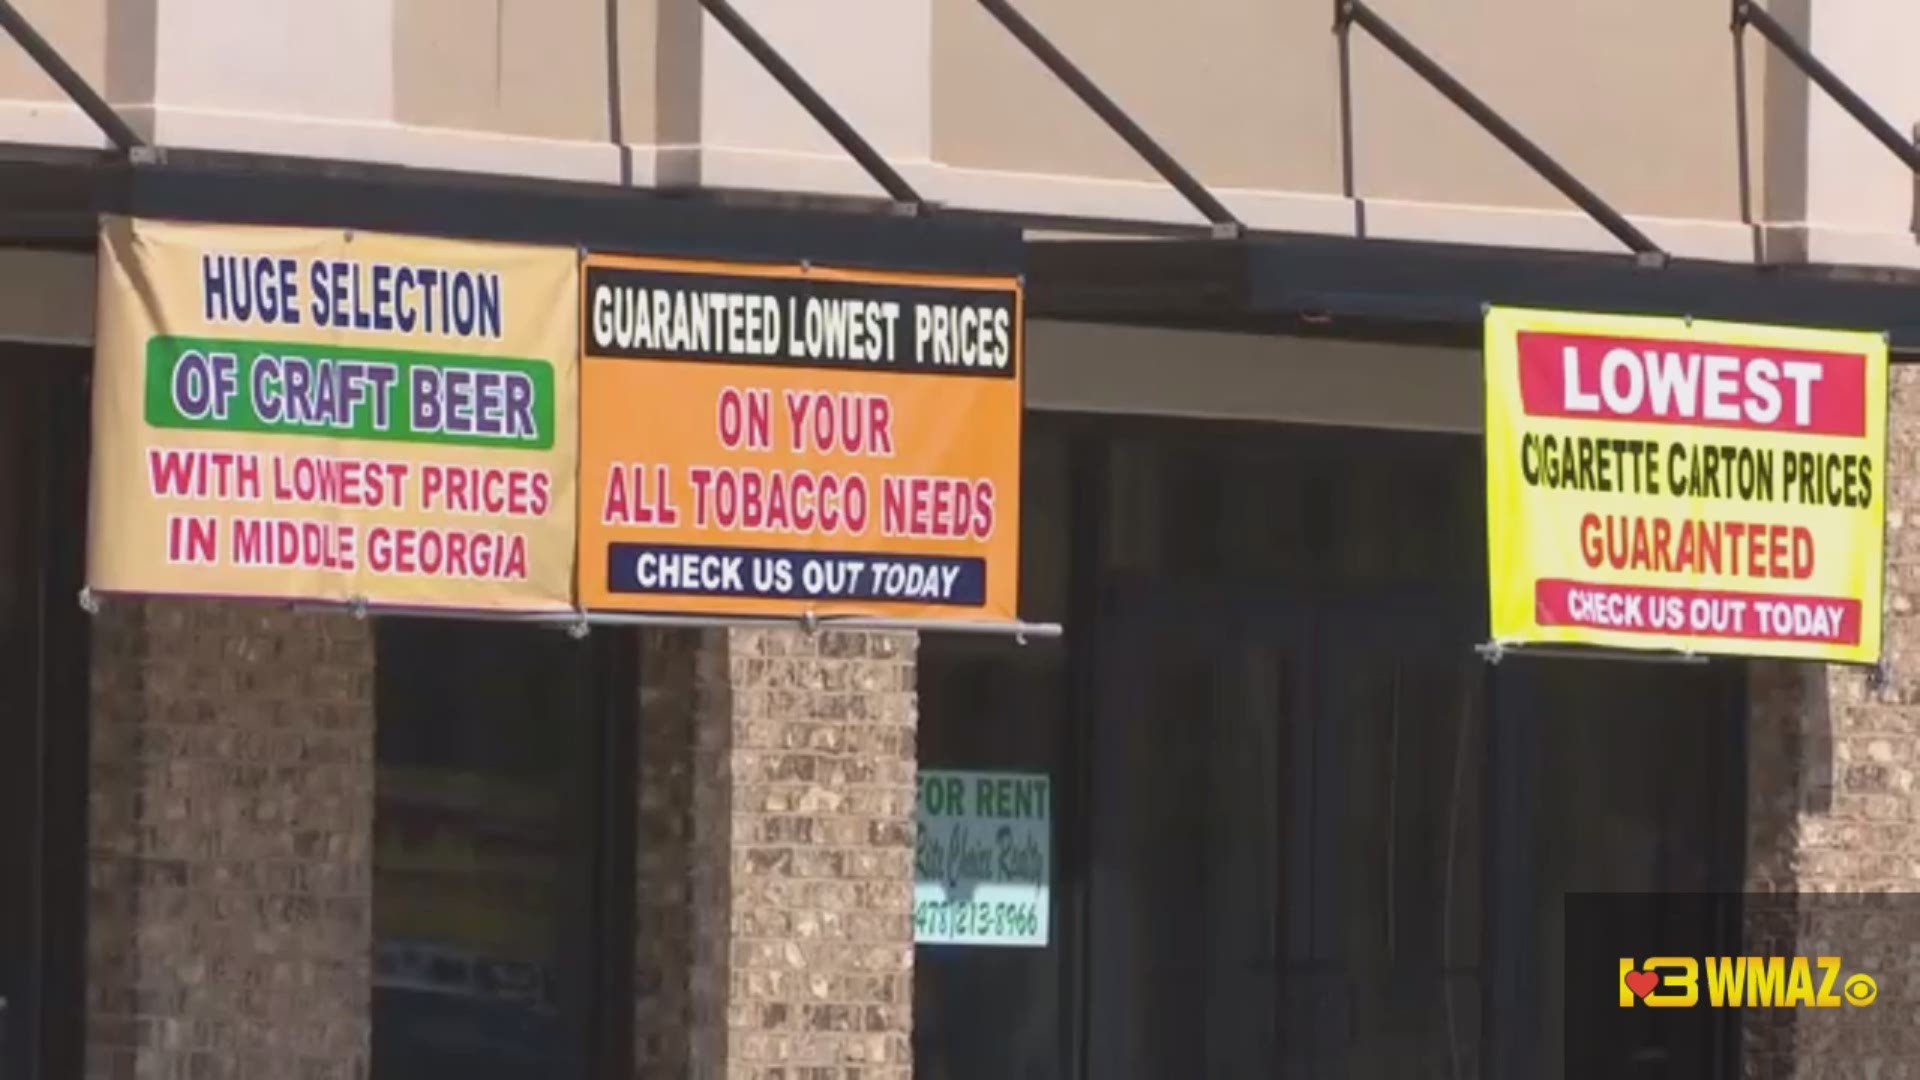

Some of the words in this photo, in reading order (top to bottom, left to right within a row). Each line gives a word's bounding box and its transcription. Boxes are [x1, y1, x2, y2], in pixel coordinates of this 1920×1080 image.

[202, 254, 300, 325] HUGE
[311, 261, 502, 339] SELECTION
[593, 286, 781, 355] GUARANTEED
[789, 297, 899, 362] LOWEST
[916, 305, 1009, 368] PRICES
[173, 350, 238, 419] OF
[251, 354, 398, 430] CRAFT
[410, 365, 537, 438] BEER
[1563, 346, 1822, 426] LOWEST
[718, 389, 770, 449] ON
[787, 392, 891, 454] YOUR
[150, 449, 260, 498] WITH
[273, 456, 408, 508] LOWEST
[420, 466, 550, 516] PRICES
[604, 466, 677, 525] ALL
[691, 469, 868, 534] TOBACCO
[883, 479, 994, 539] NEEDS
[1522, 432, 1659, 494] CIGARETTE
[1667, 442, 1773, 501] CARTON
[1783, 450, 1872, 509] PRICES
[168, 517, 216, 561] IN
[233, 519, 355, 570] MIDDLE
[367, 527, 528, 579] GEORGIA
[637, 554, 743, 591] CHECK
[753, 558, 792, 593] US
[803, 561, 863, 594] OUT
[870, 563, 960, 597] TODAY
[1580, 513, 1815, 580] GUARANTEED
[1568, 589, 1645, 624] CHECK
[1649, 595, 1683, 628] US
[1690, 598, 1746, 631] OUT
[1755, 603, 1844, 636] TODAY
[976, 778, 1048, 820] RENT
